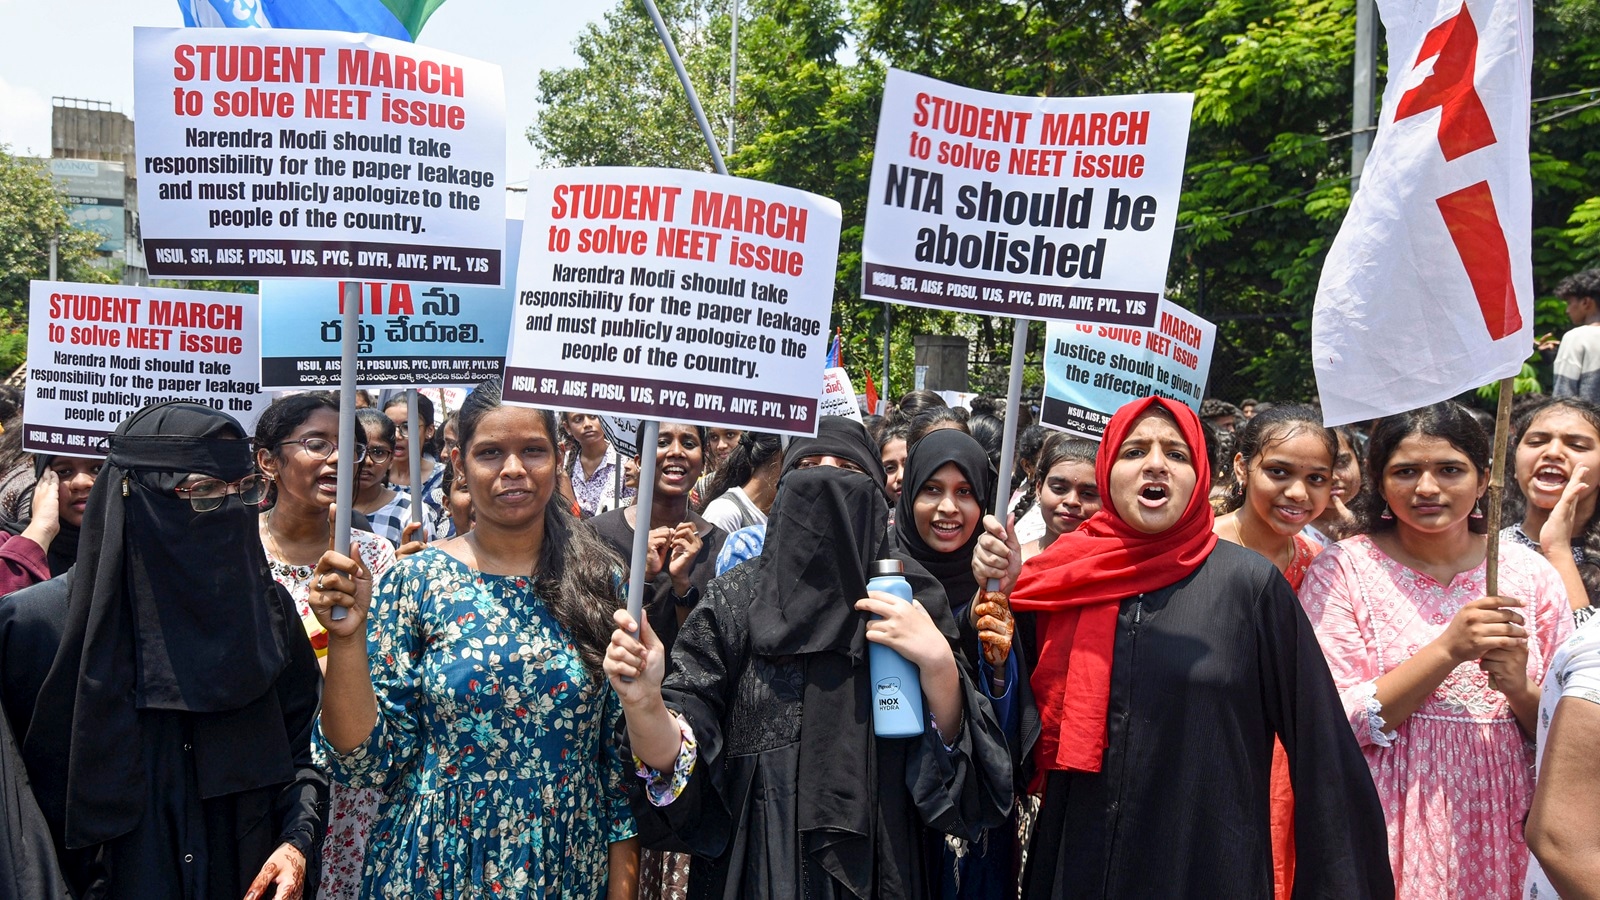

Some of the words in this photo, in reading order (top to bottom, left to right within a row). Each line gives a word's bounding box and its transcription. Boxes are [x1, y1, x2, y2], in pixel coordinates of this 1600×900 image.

[174, 45, 325, 83] STUDENT
[338, 49, 464, 97] MARCH
[174, 88, 203, 116] to
[214, 87, 294, 118] solve
[305, 89, 371, 120] NEET
[382, 93, 465, 130] issue
[914, 93, 1032, 144] STUDENT
[1040, 111, 1150, 146] MARCH
[186, 128, 272, 148] Narendra
[280, 129, 326, 150] Modi
[333, 131, 401, 154] should
[408, 137, 451, 158] take
[910, 132, 931, 160] to
[938, 141, 1000, 172] solve
[1008, 148, 1067, 177] NEET
[1073, 151, 1144, 178] issue
[54, 162, 95, 171] MANAC
[145, 154, 273, 176] responsibility
[280, 155, 308, 175] for
[314, 156, 346, 176] the
[353, 161, 411, 180] paper
[418, 163, 494, 188] leakage
[159, 180, 192, 200] and
[199, 182, 245, 200] must
[252, 181, 329, 204] publicly
[333, 185, 420, 205] apologize
[422, 189, 442, 208] to
[449, 191, 480, 211] the
[552, 184, 682, 222] STUDENT
[691, 190, 807, 243] MARCH
[884, 164, 943, 215] NTA
[956, 181, 1094, 229] should
[1104, 188, 1157, 231] be
[209, 207, 273, 228] people
[279, 208, 299, 227] of
[305, 208, 337, 228] the
[344, 212, 426, 234] country.
[156, 248, 187, 264] NSUI,
[191, 248, 212, 265] SFI,
[217, 249, 244, 265] AISF,
[249, 249, 286, 265] PDSU,
[291, 249, 318, 266] VJS,
[323, 250, 353, 267] PYC,
[358, 251, 392, 269] DYFI,
[397, 253, 428, 270] AIYF,
[433, 255, 461, 272] PYL,
[466, 257, 489, 272] YJS
[548, 225, 571, 253] to
[578, 225, 648, 256] solve
[656, 227, 722, 262] NEET
[730, 236, 803, 276] issue
[915, 224, 1107, 279] abolished
[422, 287, 460, 316] ను
[553, 264, 624, 285] Narendra
[630, 267, 675, 289] Modi
[681, 272, 746, 297] should
[751, 282, 788, 305] take
[872, 272, 898, 290] NSUI,
[900, 276, 918, 292] SFI,
[920, 279, 943, 296] AISF,
[946, 283, 978, 300] PDSU,
[983, 287, 1004, 303] VJS,
[1008, 290, 1034, 306] PYC,
[1038, 293, 1065, 309] DYFI,
[1068, 295, 1094, 312] AIYF,
[1097, 298, 1121, 314] PYL,
[1126, 300, 1146, 315] YJS
[50, 293, 141, 323] STUDENT
[149, 300, 242, 330] MARCH
[385, 316, 484, 343] చేయాలి.
[520, 290, 623, 312] responsibility
[629, 293, 655, 313] for
[661, 296, 691, 316] the
[697, 302, 752, 324] paper
[757, 308, 820, 336] leakage
[49, 323, 65, 343] to
[71, 325, 120, 347] solve
[127, 328, 172, 350] NEET
[180, 332, 242, 354] issue
[526, 314, 553, 331] and
[556, 317, 597, 334] must
[601, 318, 673, 342] publicly
[676, 327, 757, 350] apologize
[759, 335, 776, 354] to
[781, 338, 807, 359] the
[1160, 311, 1202, 350] MARCH
[54, 351, 106, 368] Narendra
[110, 355, 140, 370] Modi
[145, 358, 194, 373] should
[199, 361, 231, 375] take
[297, 361, 322, 371] NSUI,
[325, 361, 341, 370] AIS
[412, 360, 430, 370] PYC,
[432, 361, 451, 370] DYFI,
[453, 361, 471, 370] AIYF,
[562, 343, 617, 362] people
[623, 346, 642, 364] of
[647, 347, 678, 368] the
[684, 354, 759, 379] country.
[1145, 330, 1171, 357] NEET
[1173, 343, 1198, 371] issue
[31, 369, 106, 387] responsibility
[110, 373, 128, 387] for
[132, 375, 154, 389] the
[158, 378, 201, 392] paper
[205, 378, 263, 395] leakage
[1053, 338, 1106, 365] Justice
[1110, 354, 1154, 379] should
[1157, 366, 1169, 385] be
[1170, 374, 1193, 396] given
[1193, 384, 1201, 400] to
[1066, 364, 1090, 384] the
[1094, 373, 1151, 397] affected
[37, 386, 56, 399] and
[59, 389, 88, 402] must
[92, 391, 141, 408] publicly
[209, 397, 223, 410] to
[228, 397, 252, 411] the
[65, 408, 105, 422] people
[109, 410, 121, 423] of
[512, 375, 537, 394] NSUI,
[540, 378, 559, 396] SFI,
[562, 380, 587, 398] AISF,
[591, 383, 625, 402] PDSU,
[631, 386, 654, 405] VJS,
[659, 389, 689, 409] PYC,
[694, 393, 726, 413] DYFI,
[730, 397, 757, 416] AIYF,
[762, 401, 785, 419] PYL,
[790, 404, 807, 421] YJS
[30, 431, 49, 443] NSUI,
[51, 433, 65, 445] SFI,
[67, 434, 86, 447] AISF,
